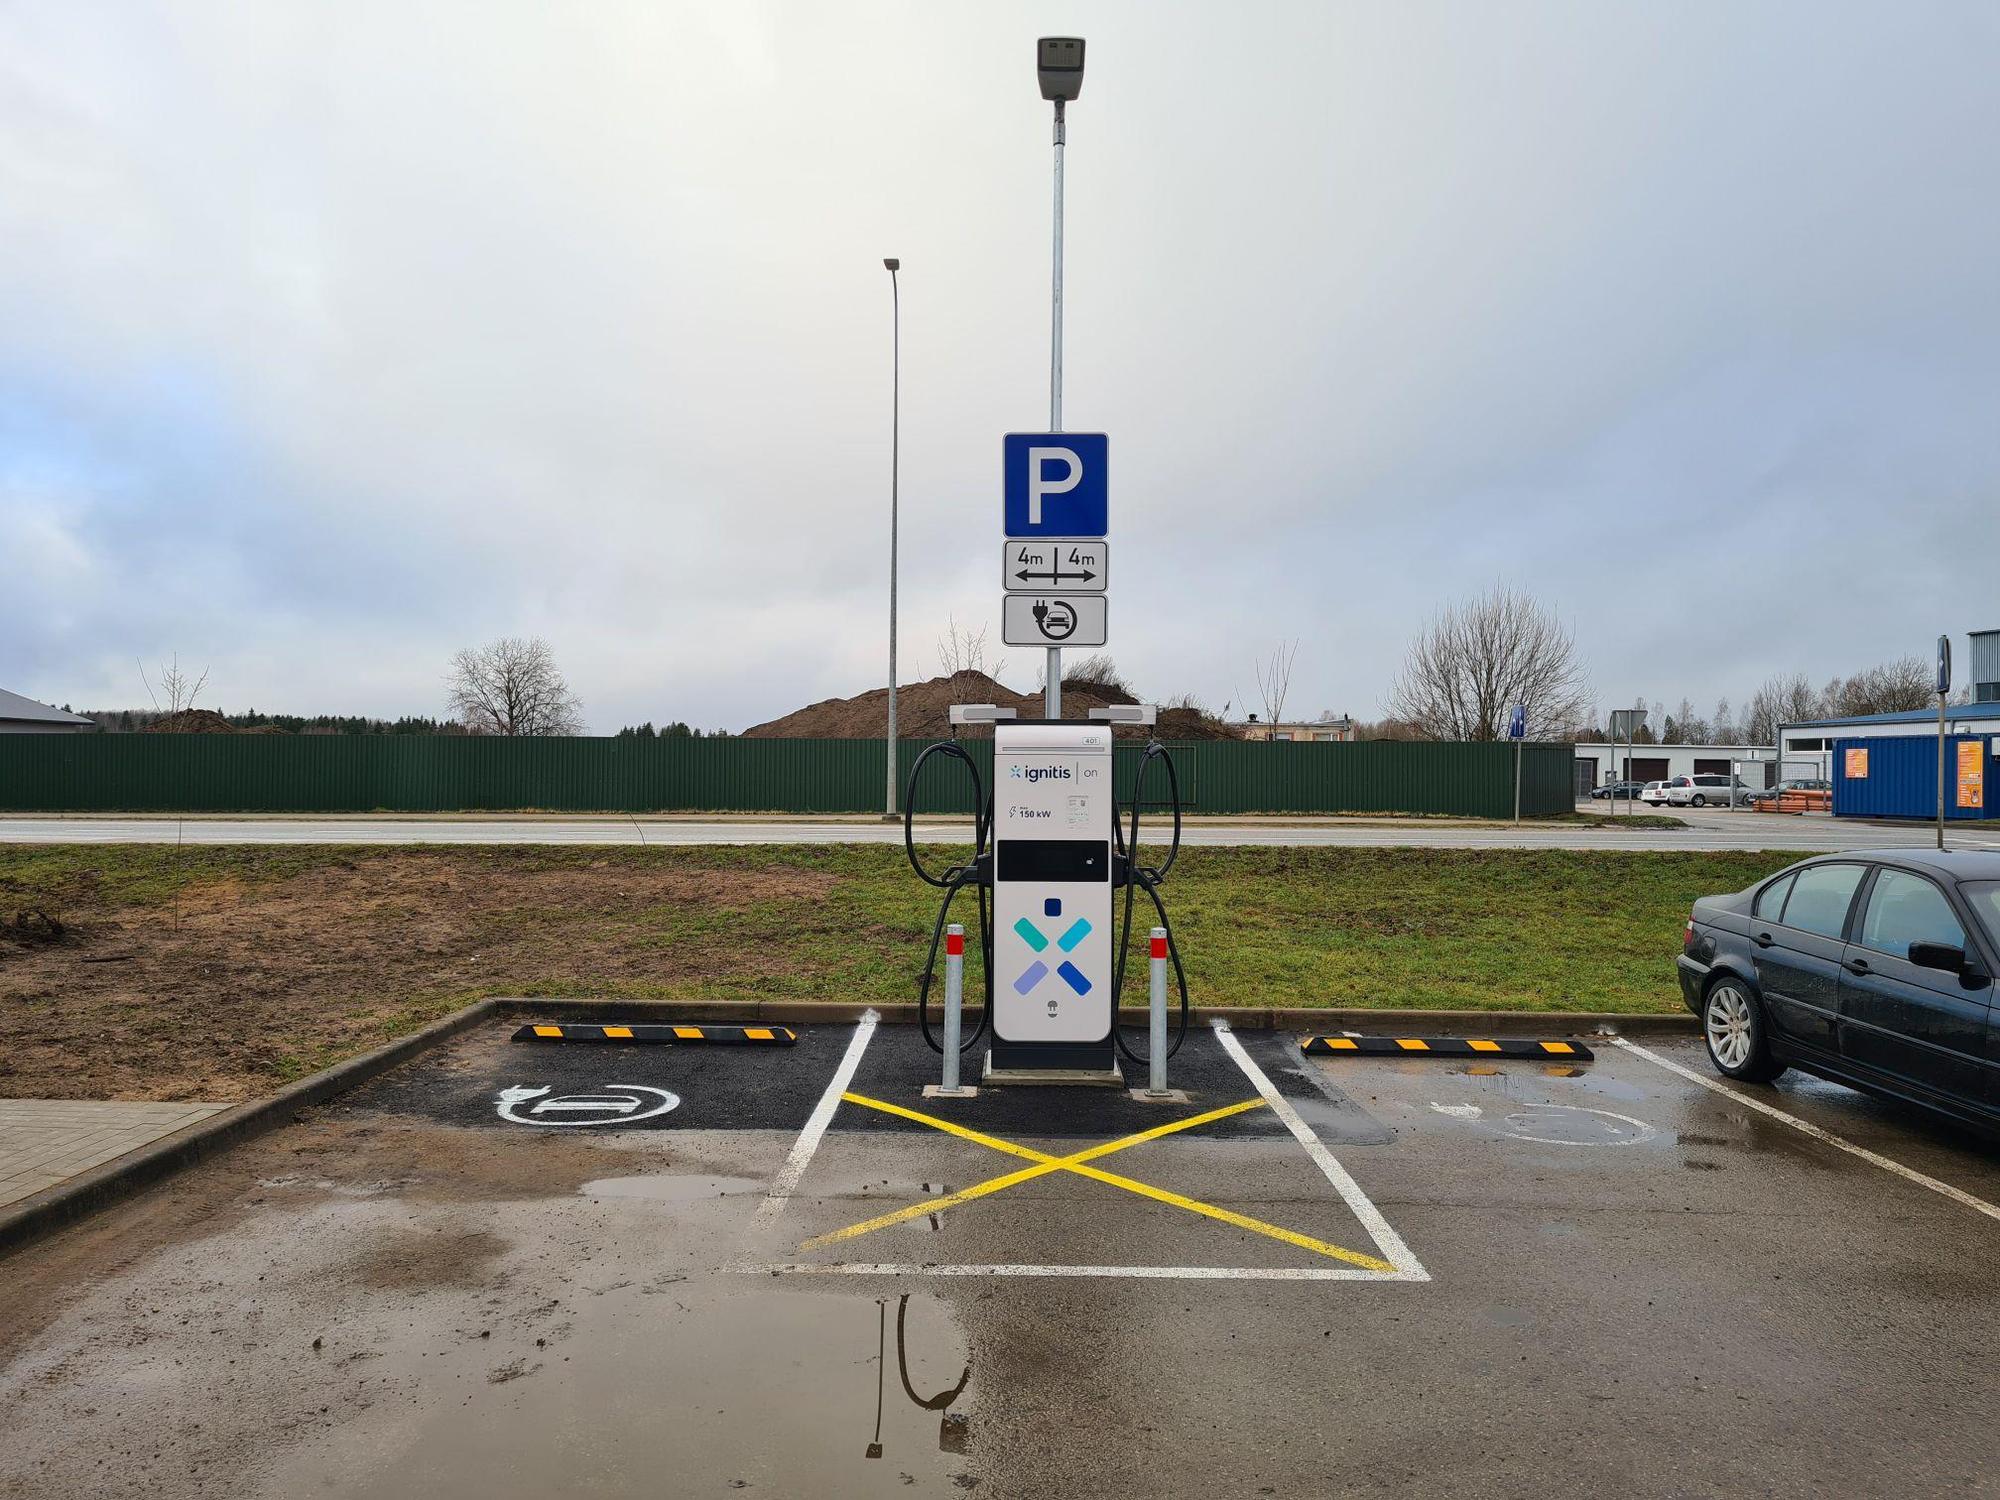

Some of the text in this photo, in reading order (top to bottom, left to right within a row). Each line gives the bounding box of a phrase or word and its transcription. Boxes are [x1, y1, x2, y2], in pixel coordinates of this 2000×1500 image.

[1029, 447, 1083, 524] P
[1018, 547, 1095, 565] 4m 4m
[1025, 765, 1097, 782] ignitis on
[1019, 810, 1051, 818] 150 kW
